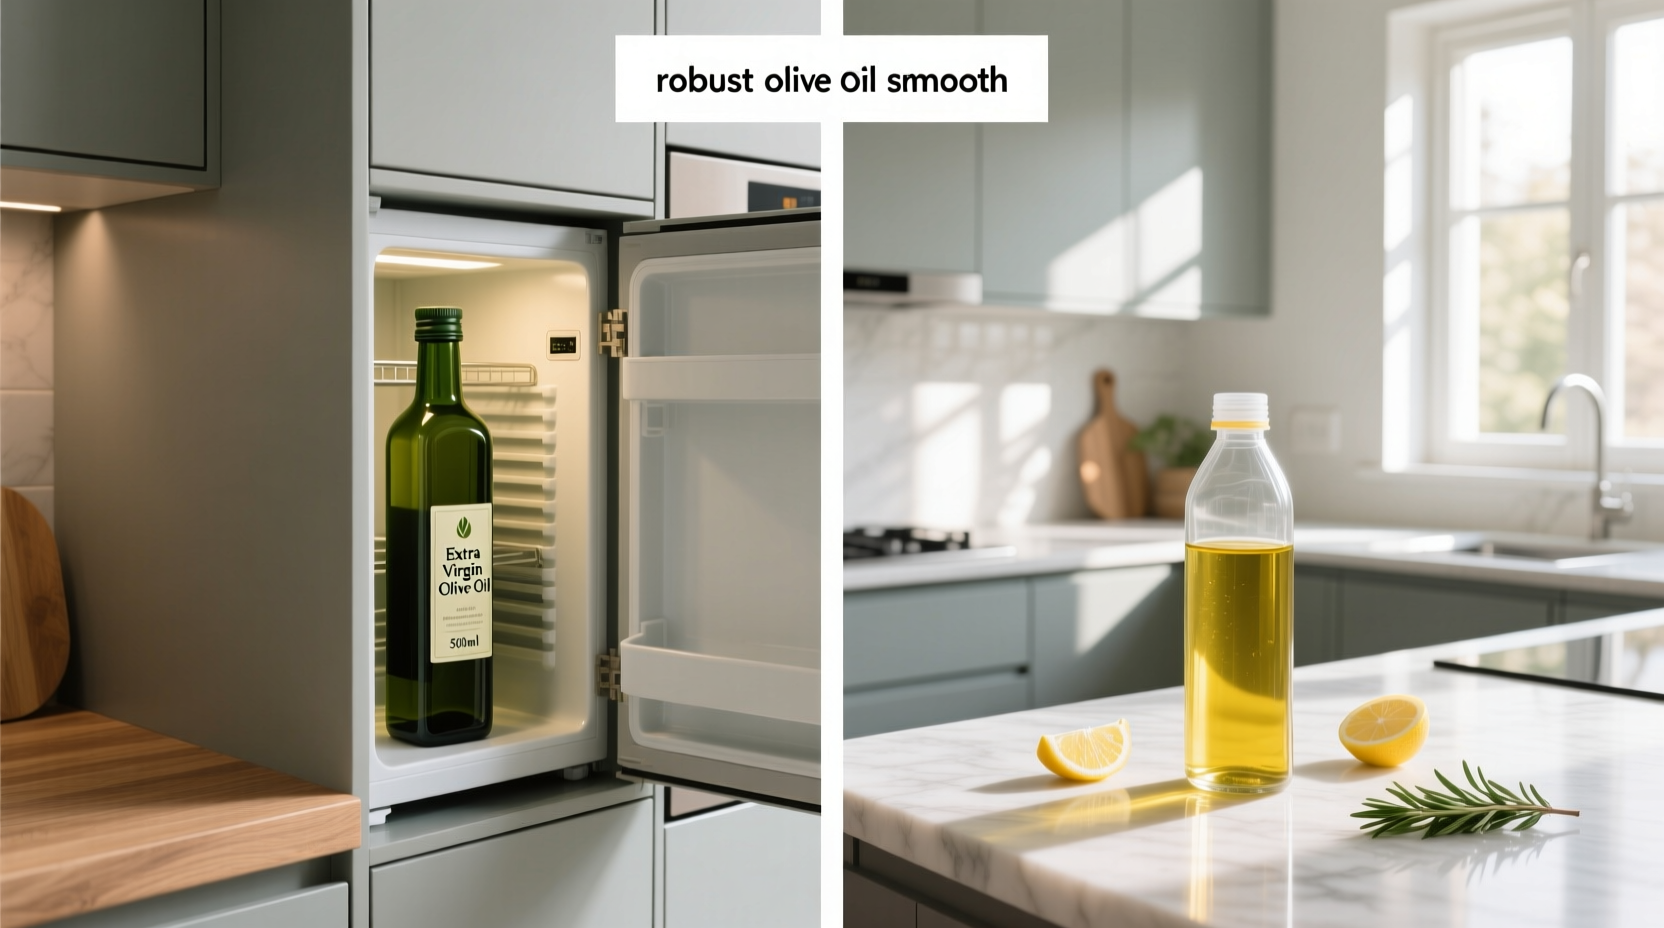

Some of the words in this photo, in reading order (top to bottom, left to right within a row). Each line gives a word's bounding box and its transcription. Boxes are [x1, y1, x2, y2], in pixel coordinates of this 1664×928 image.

[446, 546, 481, 561] Extra
[442, 563, 483, 581] Virgin
[438, 581, 472, 596] Olive
[473, 577, 491, 593] Oil
[449, 634, 479, 649] 500ml
